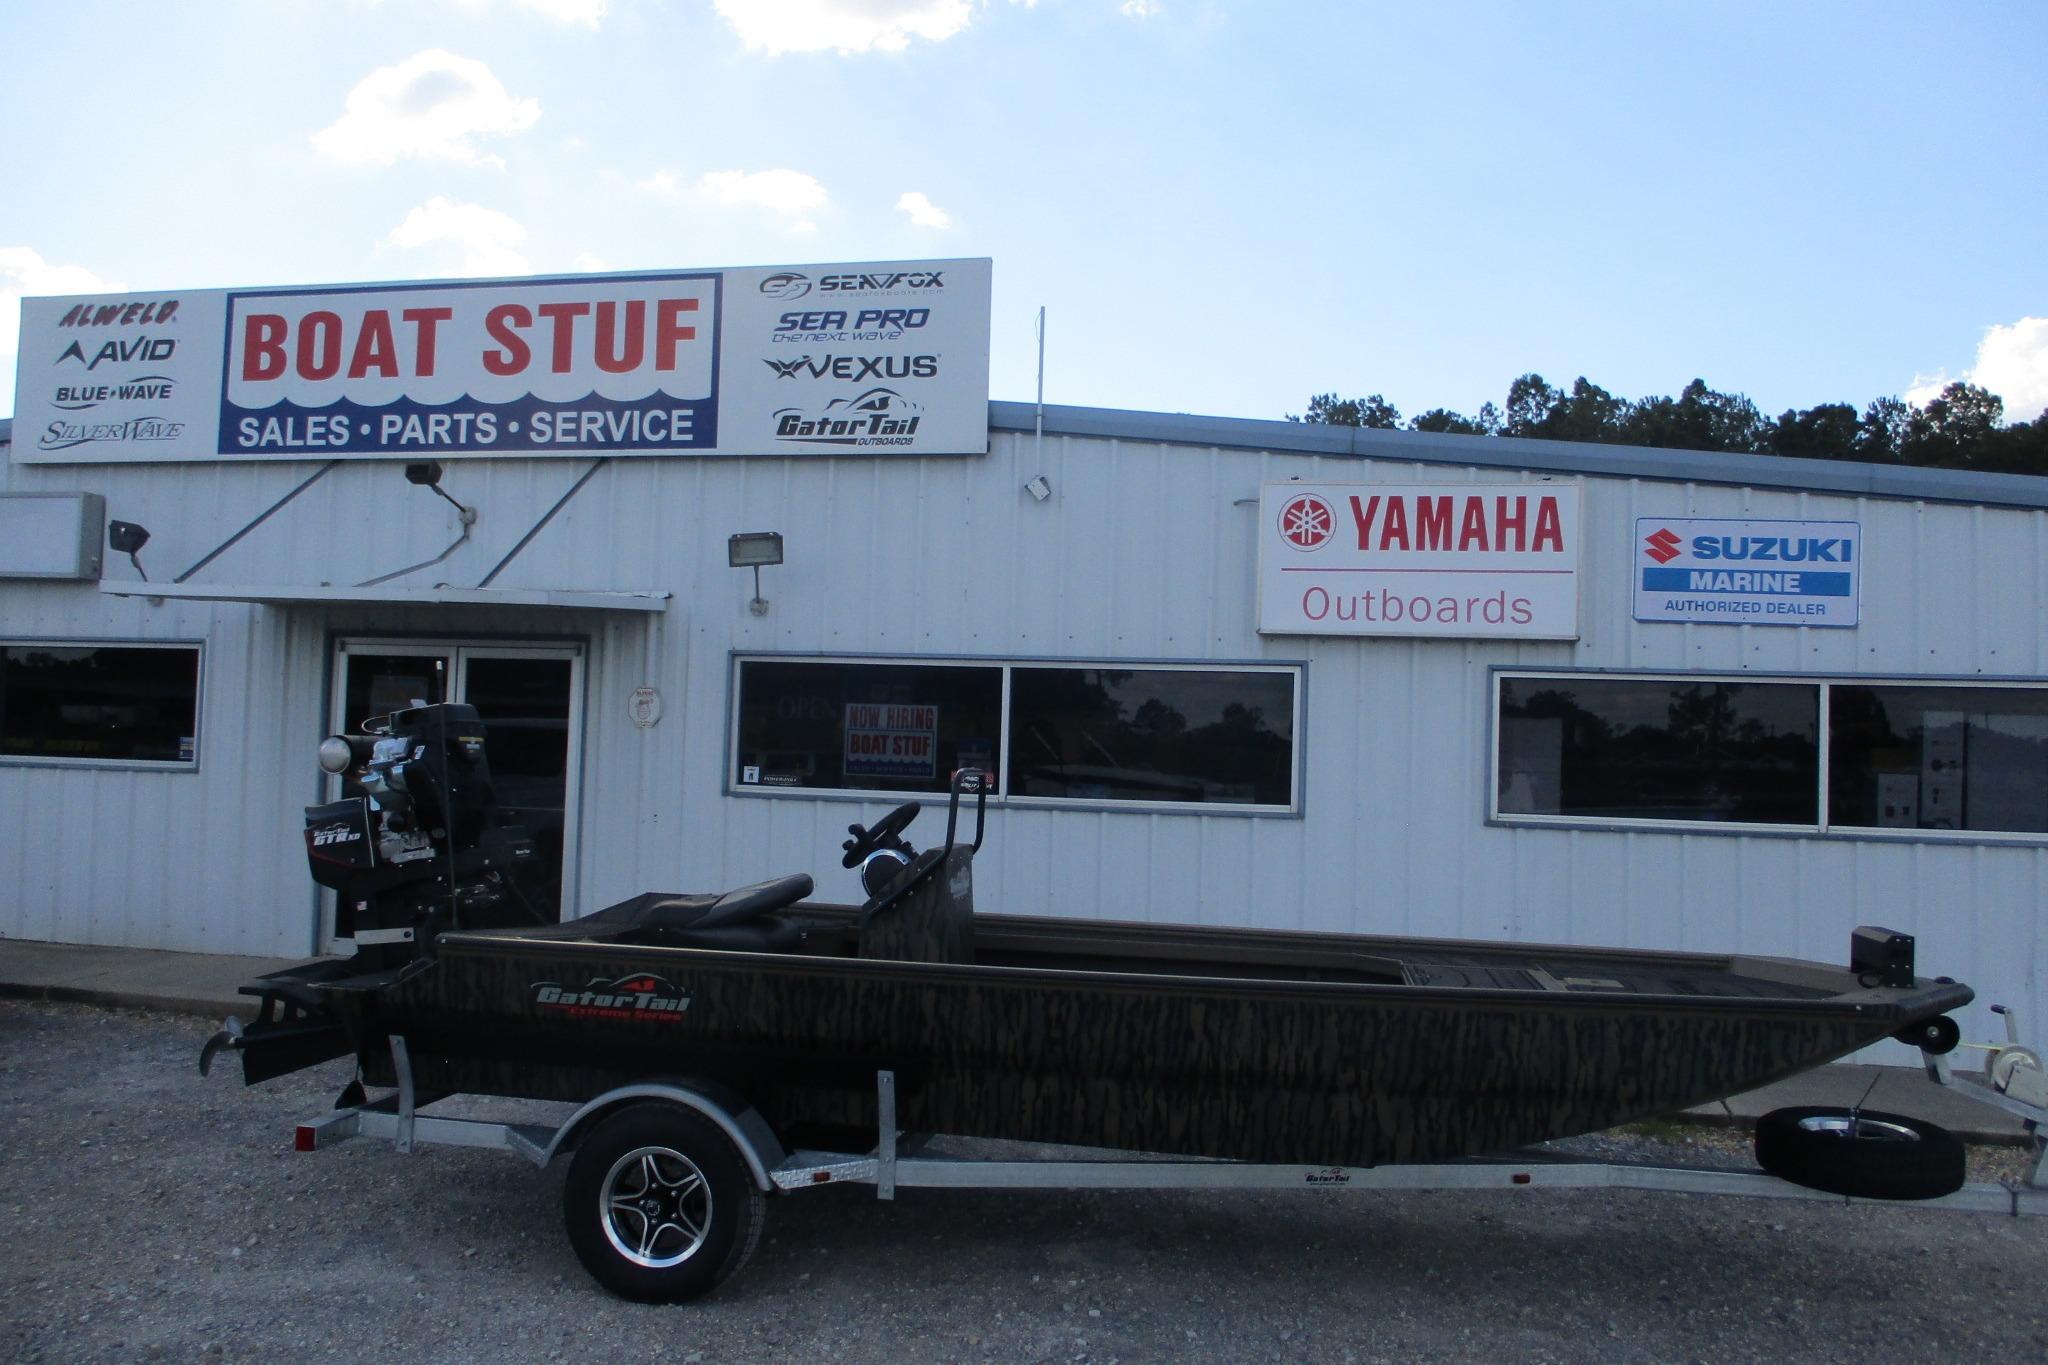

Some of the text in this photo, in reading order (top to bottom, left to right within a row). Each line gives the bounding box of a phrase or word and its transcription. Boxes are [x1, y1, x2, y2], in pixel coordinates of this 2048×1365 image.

[774, 308, 931, 332] SEA PRO
[243, 298, 700, 382] BOAT STUF
[772, 331, 901, 343] the next wave
[87, 336, 176, 370] AVID
[803, 354, 937, 382] VEXUS
[238, 409, 694, 448] SALES PARTS SERVICE
[776, 414, 920, 435] GatorTail
[857, 438, 914, 446] OUTBOARDS
[1349, 495, 1564, 552] YAMAHA
[1692, 536, 1852, 563] SUZUKI
[1689, 571, 1801, 593] MARINE
[1302, 586, 1533, 625] Outboards
[1665, 601, 1826, 615] AUTHORIZED DEALER
[850, 706, 934, 730] NOW HIRING
[851, 735, 931, 757] BOAT STUF
[536, 986, 691, 1011] GatorTail
[570, 1007, 632, 1018] Extreme
